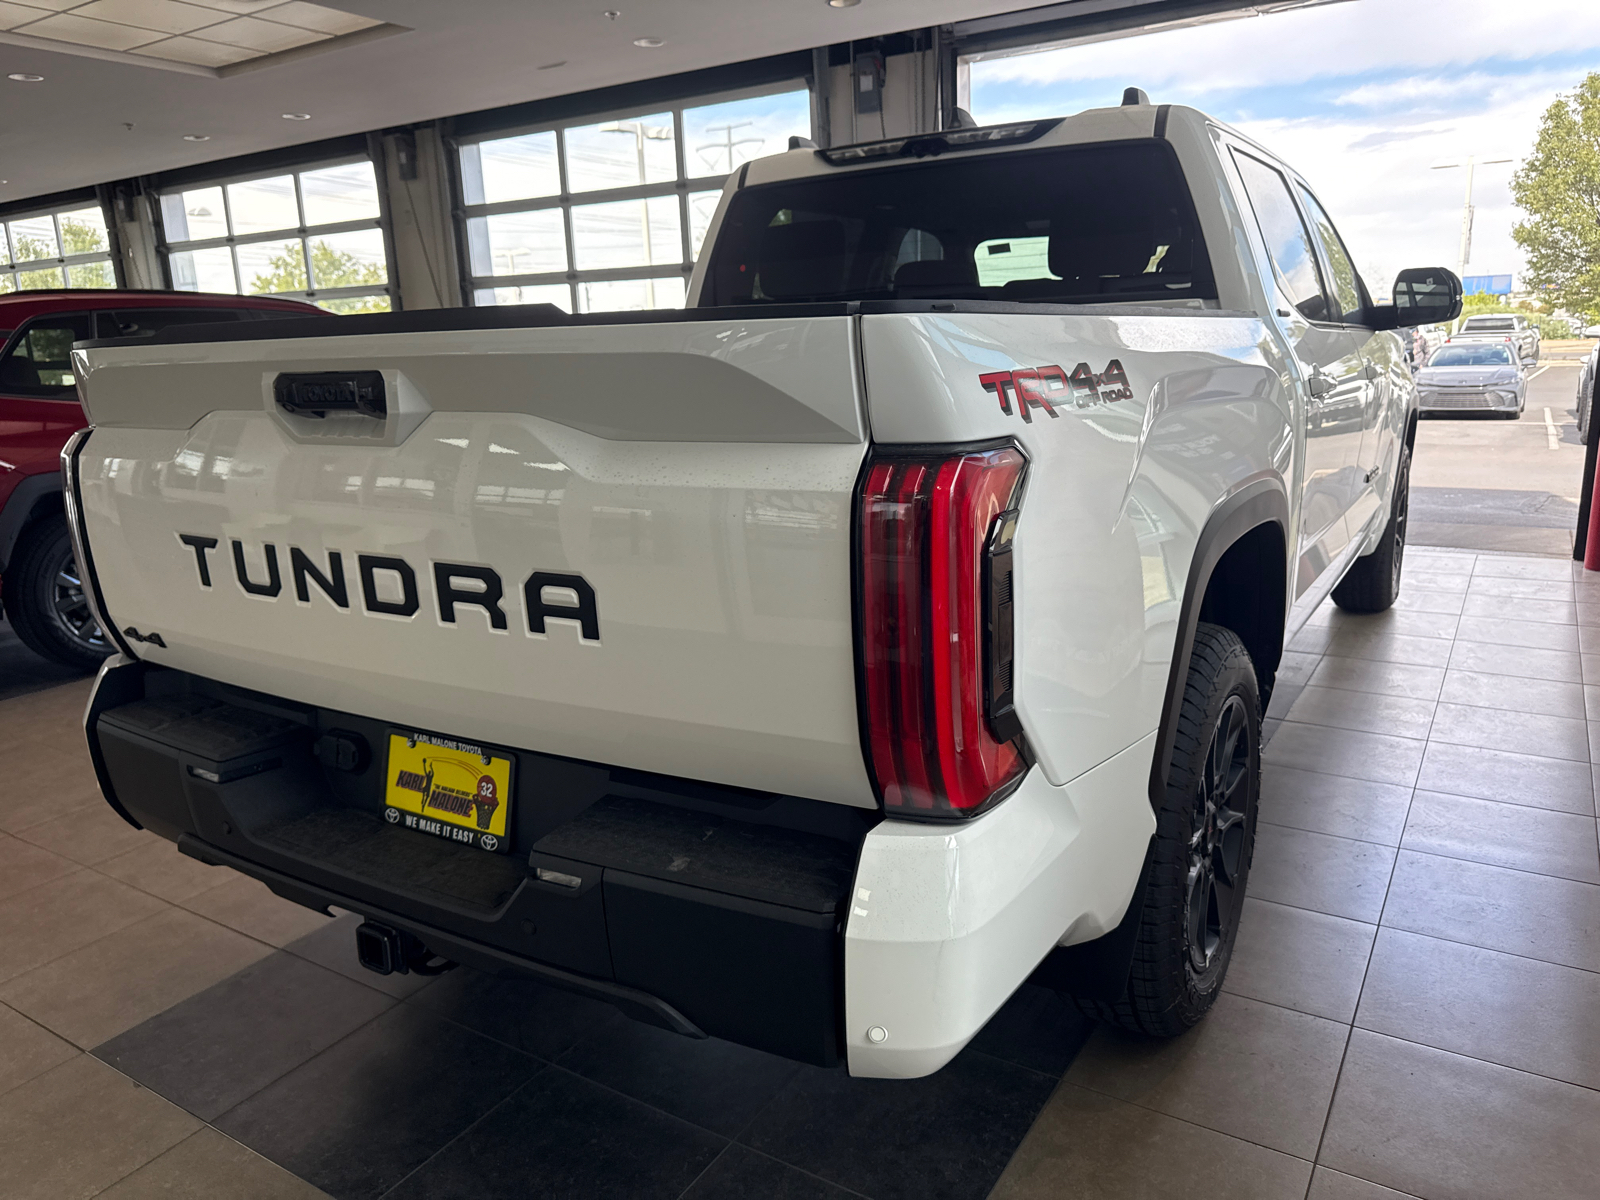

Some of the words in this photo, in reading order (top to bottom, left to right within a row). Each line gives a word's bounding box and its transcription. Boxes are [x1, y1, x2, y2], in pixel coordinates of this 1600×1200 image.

[302, 383, 353, 402] TOYOTA
[979, 364, 1074, 424] TRD
[1075, 394, 1101, 409] OFF
[1100, 387, 1134, 404] ROAD
[178, 532, 602, 645] TUNDRA
[413, 733, 431, 745] KARL
[431, 737, 457, 750] MALONE
[457, 742, 482, 756] TOYOTA
[396, 770, 426, 793] KARL
[480, 782, 493, 797] 32
[428, 789, 474, 818] MALONE
[405, 814, 417, 828] WE
[419, 818, 441, 835] MAKE
[442, 825, 451, 838] IT
[452, 827, 474, 844] EASY
